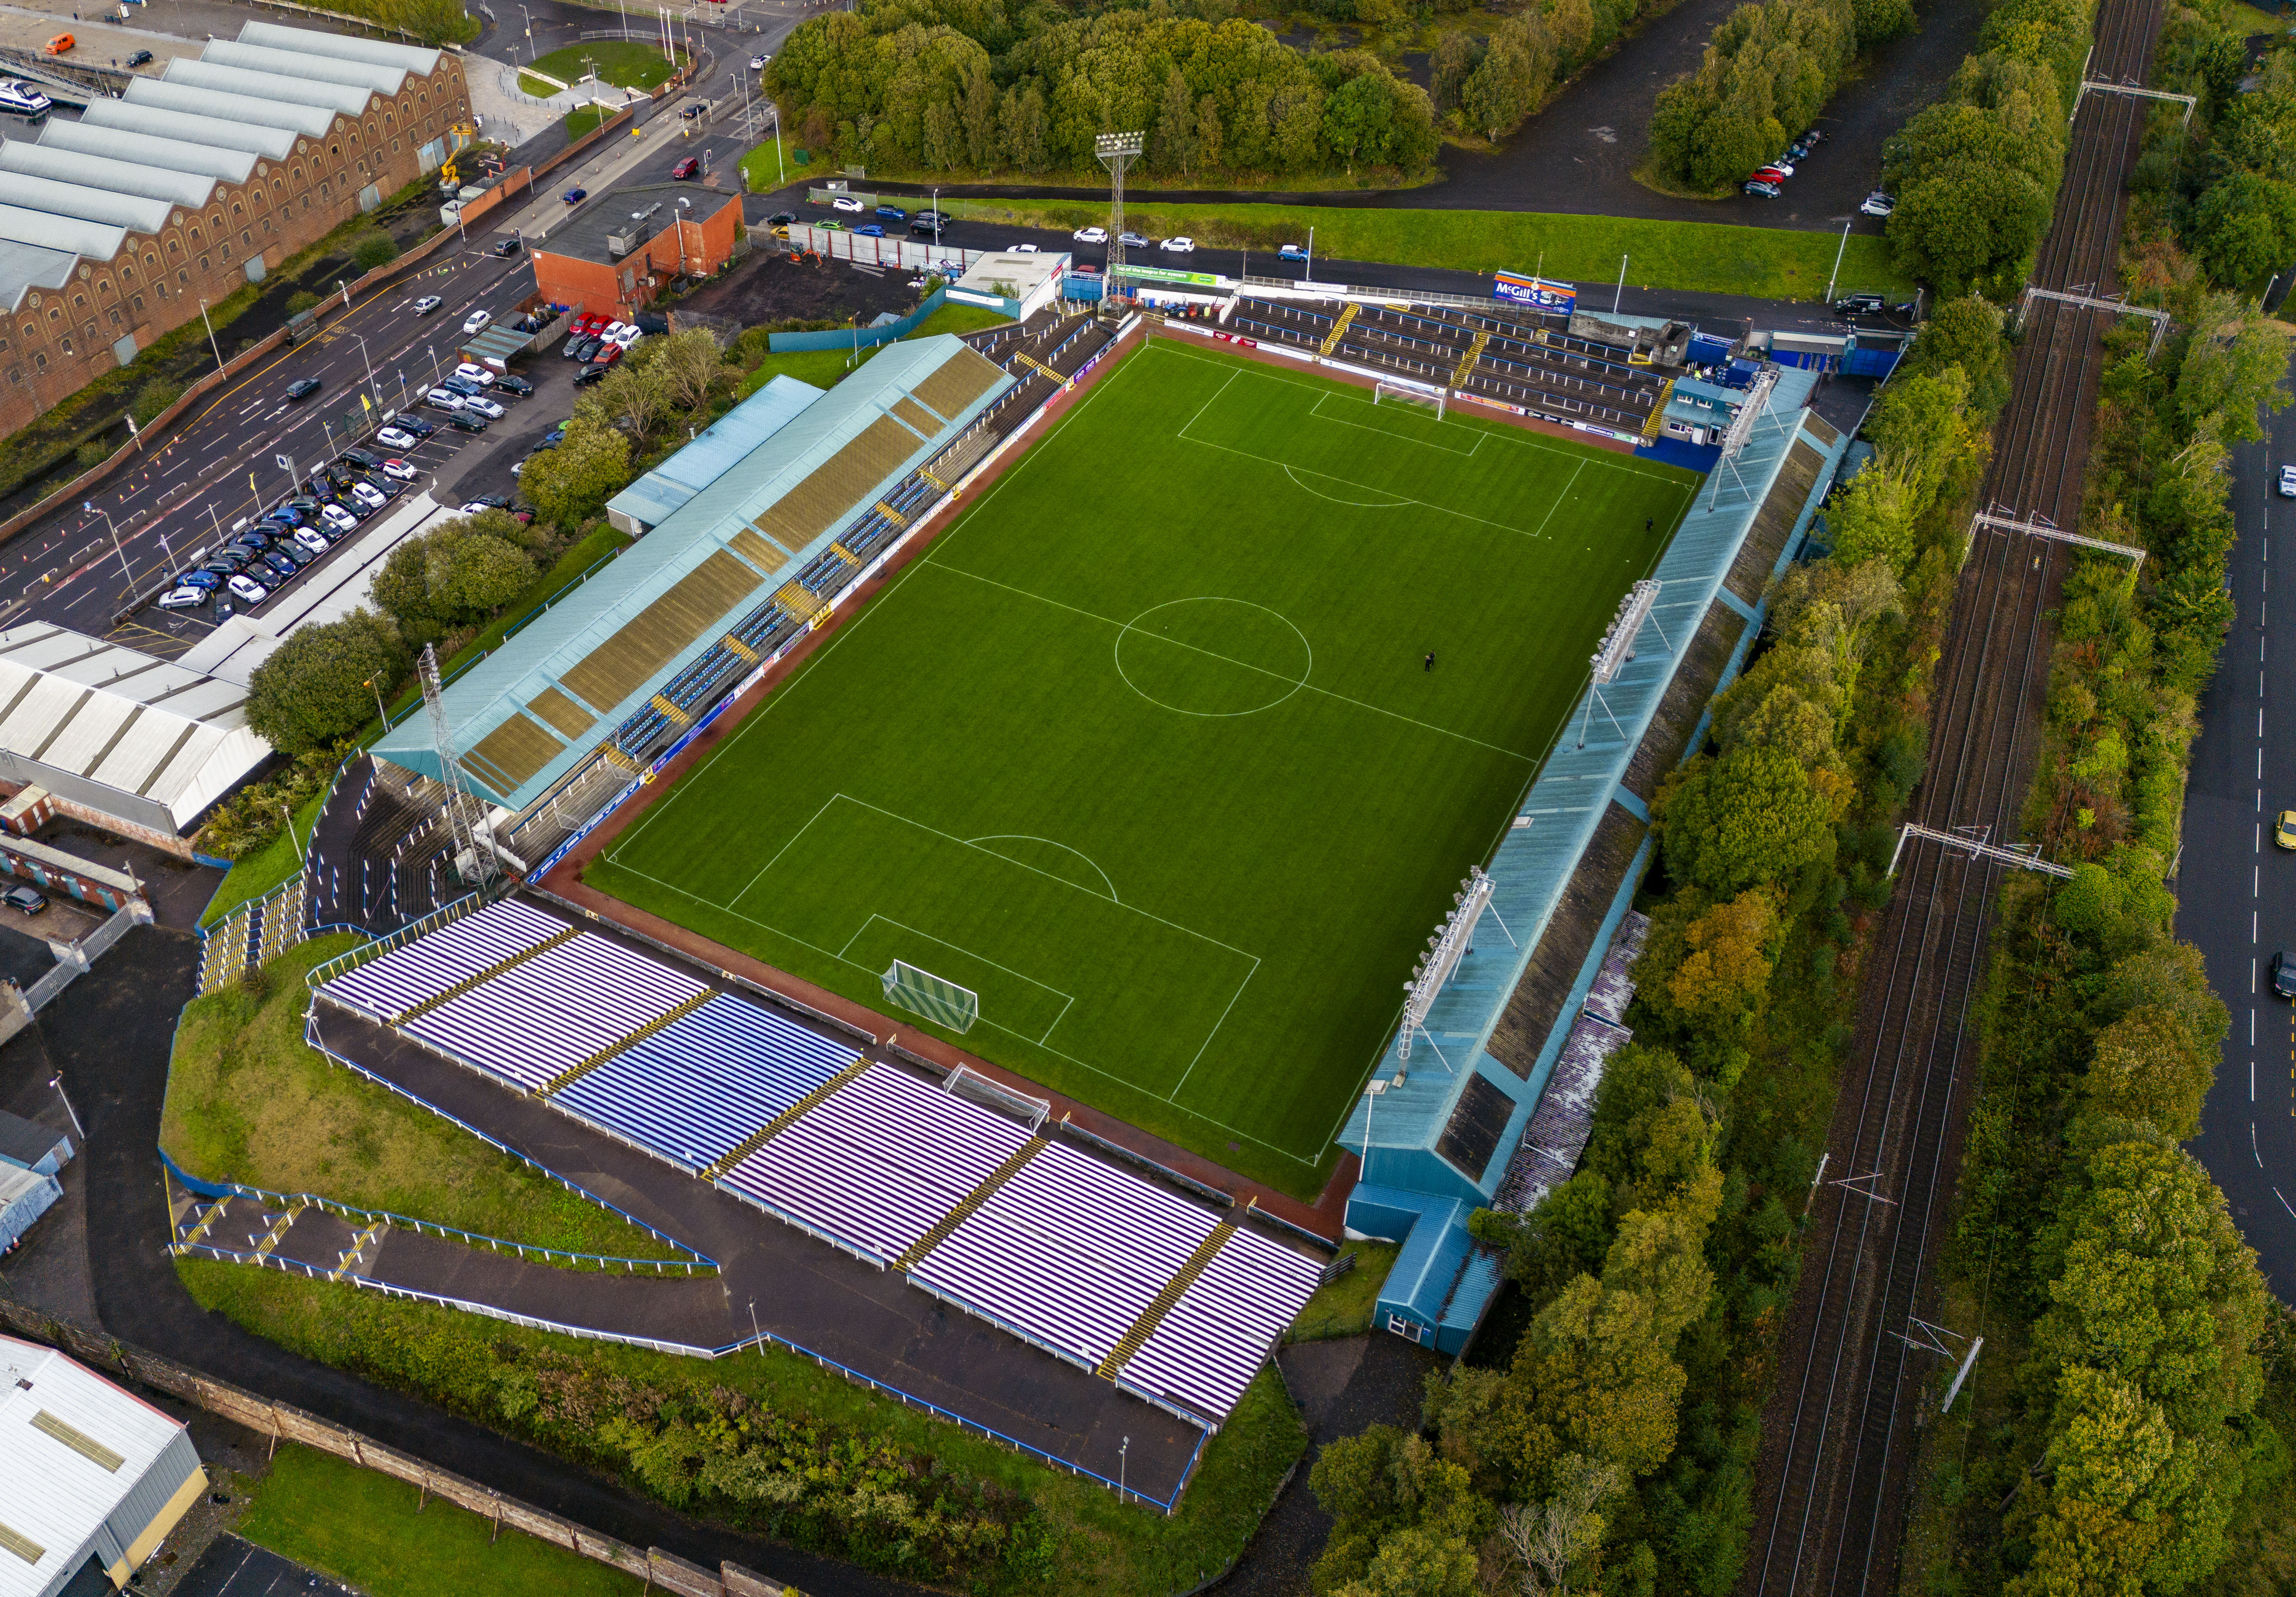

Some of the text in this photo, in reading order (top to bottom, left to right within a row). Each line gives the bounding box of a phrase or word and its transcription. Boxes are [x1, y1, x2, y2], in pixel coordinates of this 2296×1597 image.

[1496, 282, 1538, 300] McGill's
[1085, 361, 1095, 371] cinch
[1076, 370, 1084, 380] cinch
[898, 496, 949, 545] CLYDE INJURY CLINIC
[779, 637, 796, 654] Greenwood
